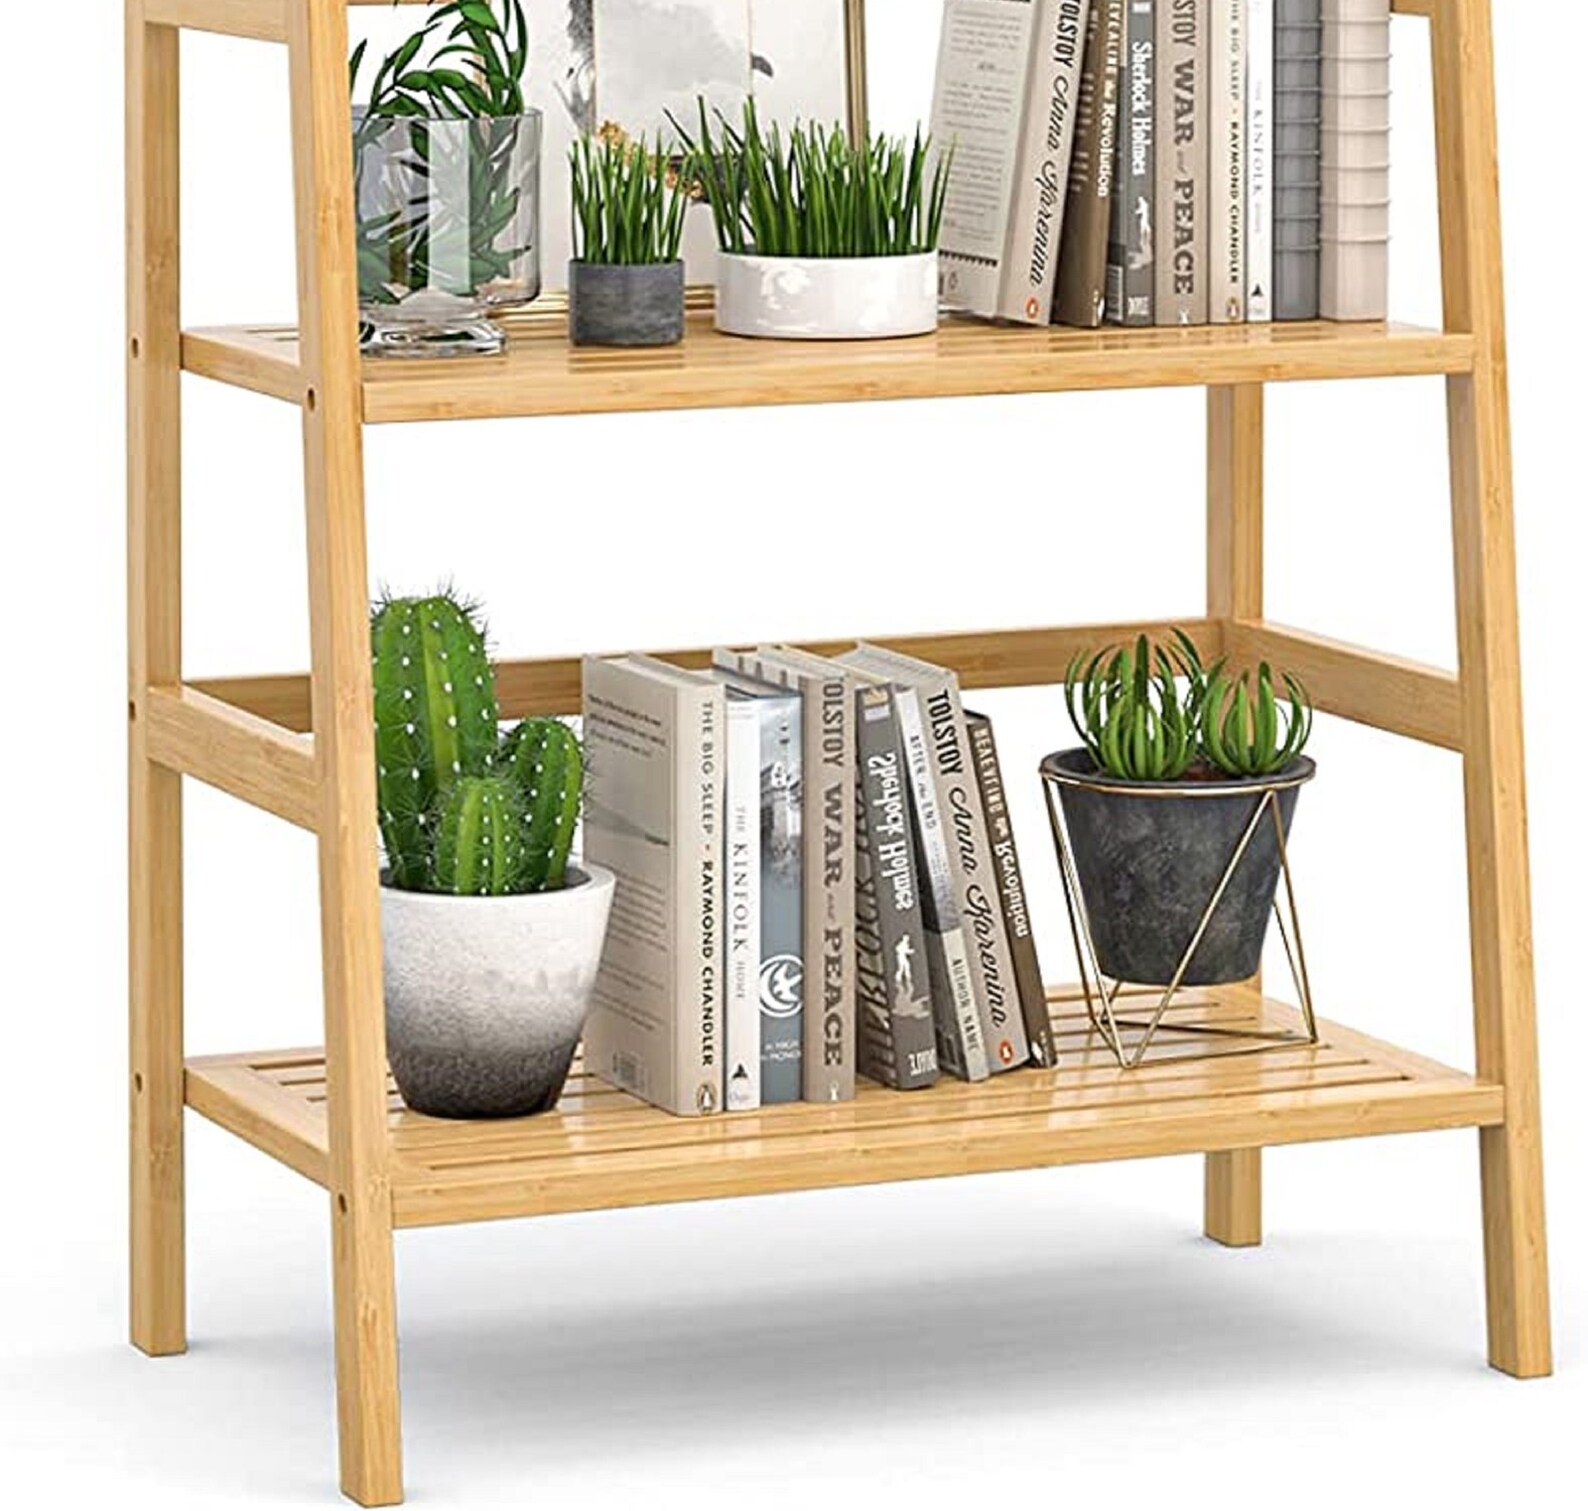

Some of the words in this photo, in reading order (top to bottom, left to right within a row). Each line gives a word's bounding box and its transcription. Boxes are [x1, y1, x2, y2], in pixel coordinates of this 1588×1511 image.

[1131, 40, 1153, 113] Sherlock
[1230, 27, 1240, 53] BIG
[1230, 60, 1240, 101] SLEEP
[1047, 74, 1070, 151] Anna
[1174, 59, 1195, 146] WAR
[1097, 103, 1117, 198] Revolution
[1131, 117, 1153, 176] Holmes
[1229, 121, 1240, 200] RAYMOND
[1253, 109, 1264, 196] KINFOLK
[1030, 160, 1060, 288] Karenina
[1174, 178, 1195, 295] PEACE
[1229, 204, 1240, 284] CHANDLER
[701, 701, 713, 733] THE
[701, 741, 714, 775] BIG
[927, 689, 963, 776] TOLSTOY
[701, 782, 714, 835] SLEEP
[735, 805, 746, 833] THE
[823, 783, 844, 888] WAR
[949, 787, 978, 875] Anna
[701, 860, 715, 959] RAYMOND
[733, 843, 749, 952] KINFOLK
[824, 927, 843, 1067] PEACE
[963, 884, 1007, 1028] Karenina
[701, 965, 715, 1066] CHANDLER
[952, 958, 969, 1009] AUTHOR
[964, 1014, 980, 1051] NAME
